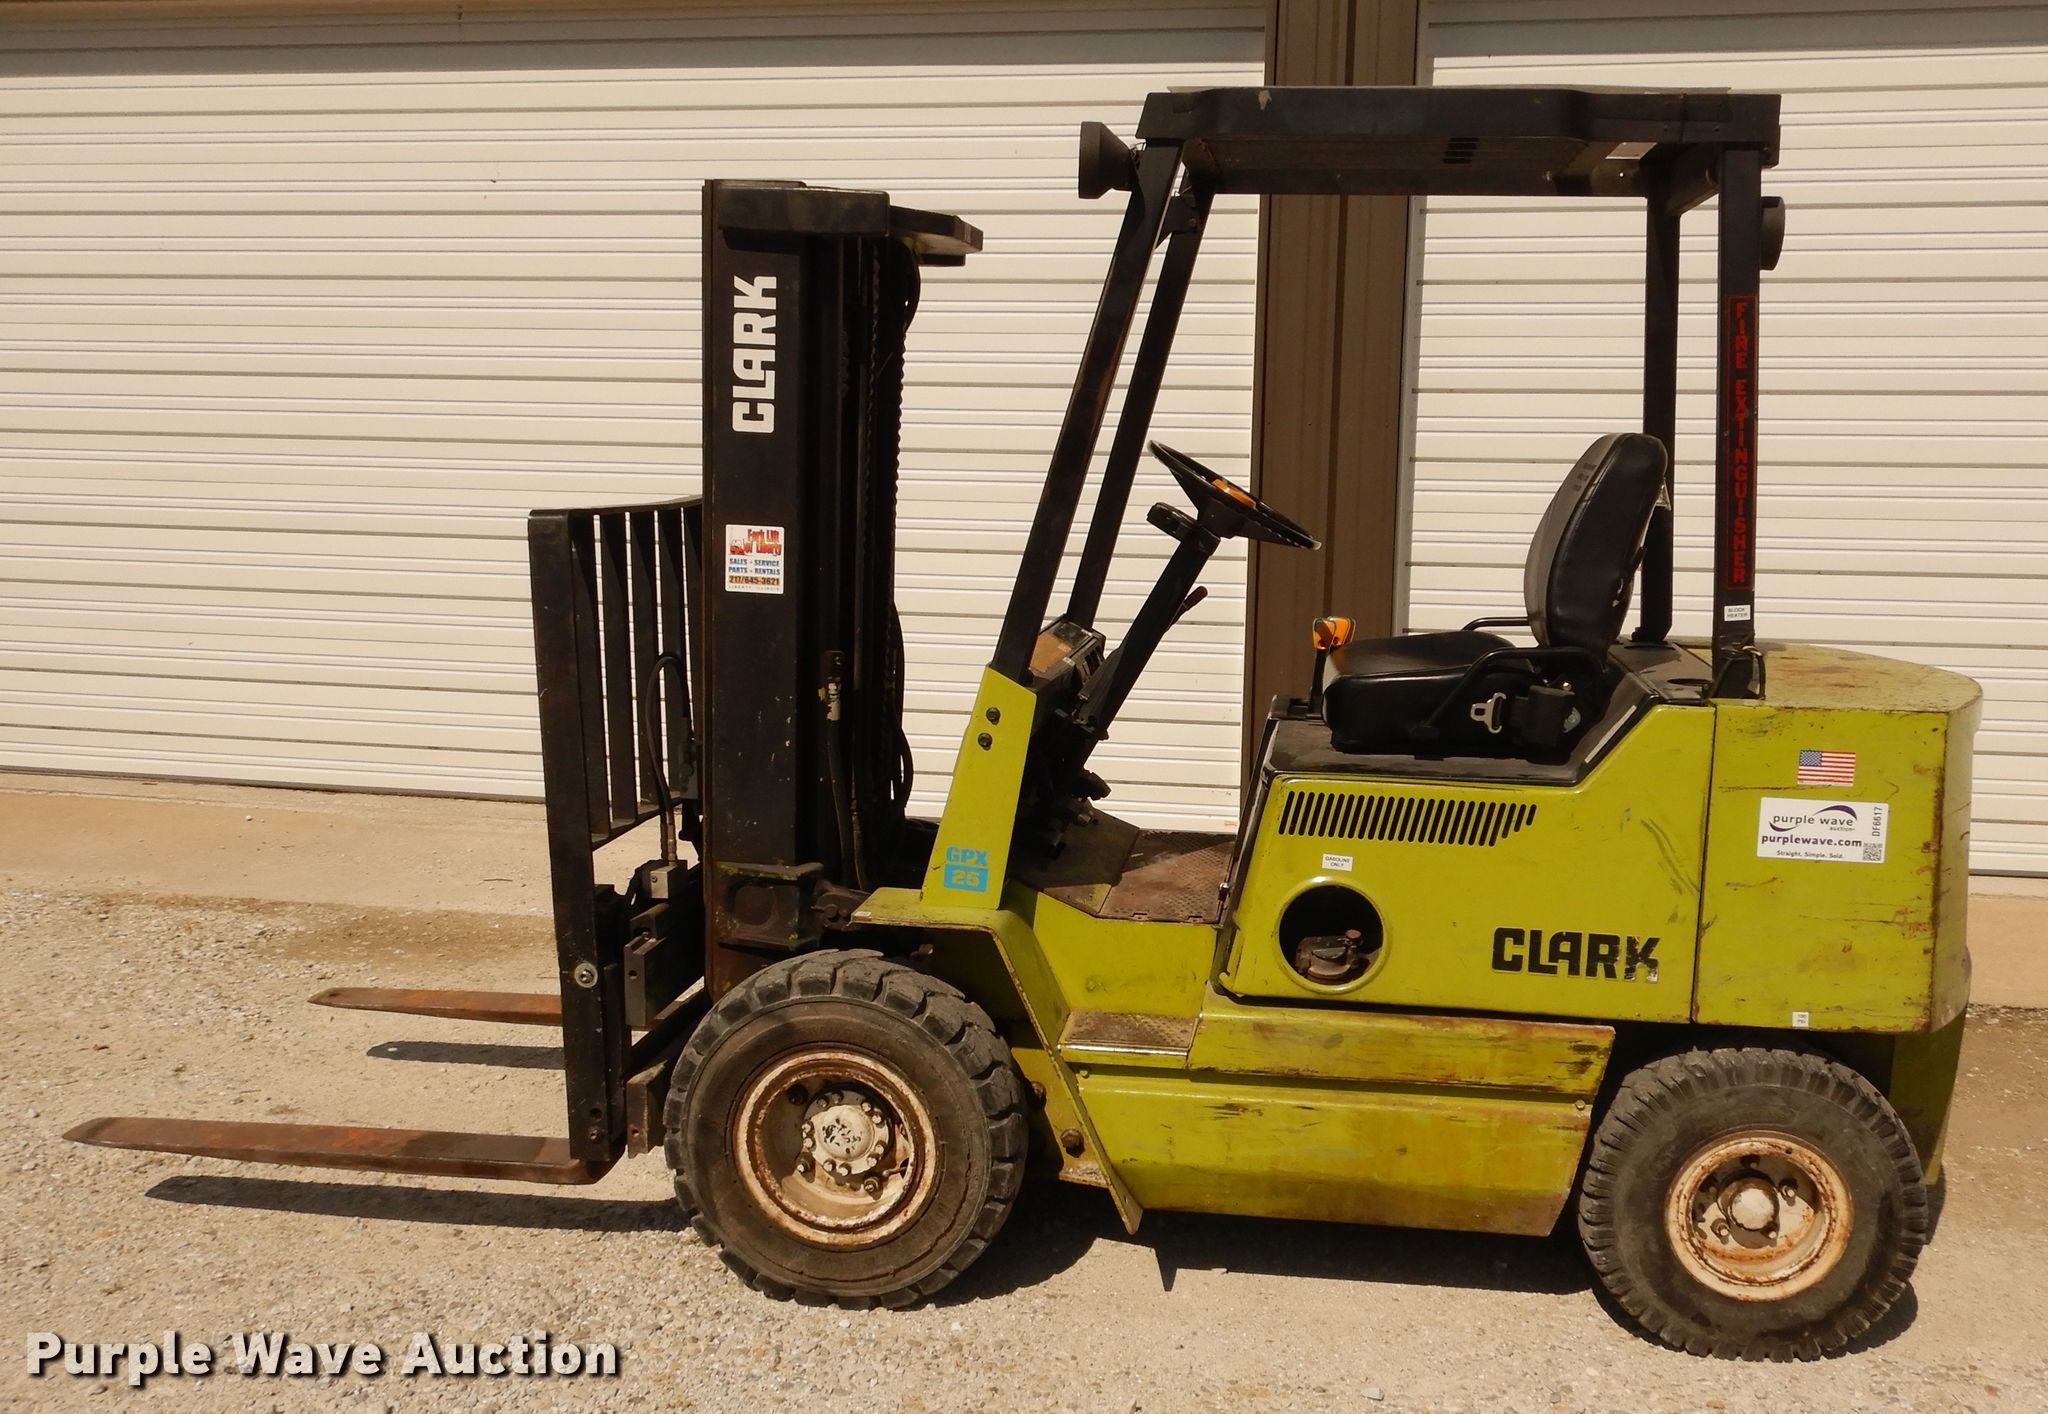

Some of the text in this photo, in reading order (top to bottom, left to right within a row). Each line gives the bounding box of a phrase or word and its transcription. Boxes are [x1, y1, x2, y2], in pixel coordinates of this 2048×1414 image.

[732, 275, 777, 433] CLARK
[1732, 303, 1749, 584] FIRE EXTINGUISHER
[754, 567, 781, 575] RENTALS
[1773, 815, 1854, 826] purple wave
[1871, 806, 1883, 837] DF6617
[1761, 834, 1862, 847] purplewave.com
[946, 846, 989, 866] GPX
[1776, 850, 1803, 858] Straight.
[1805, 851, 1827, 859] Simple.
[952, 869, 980, 887] 25
[1492, 927, 1661, 984] CLARK
